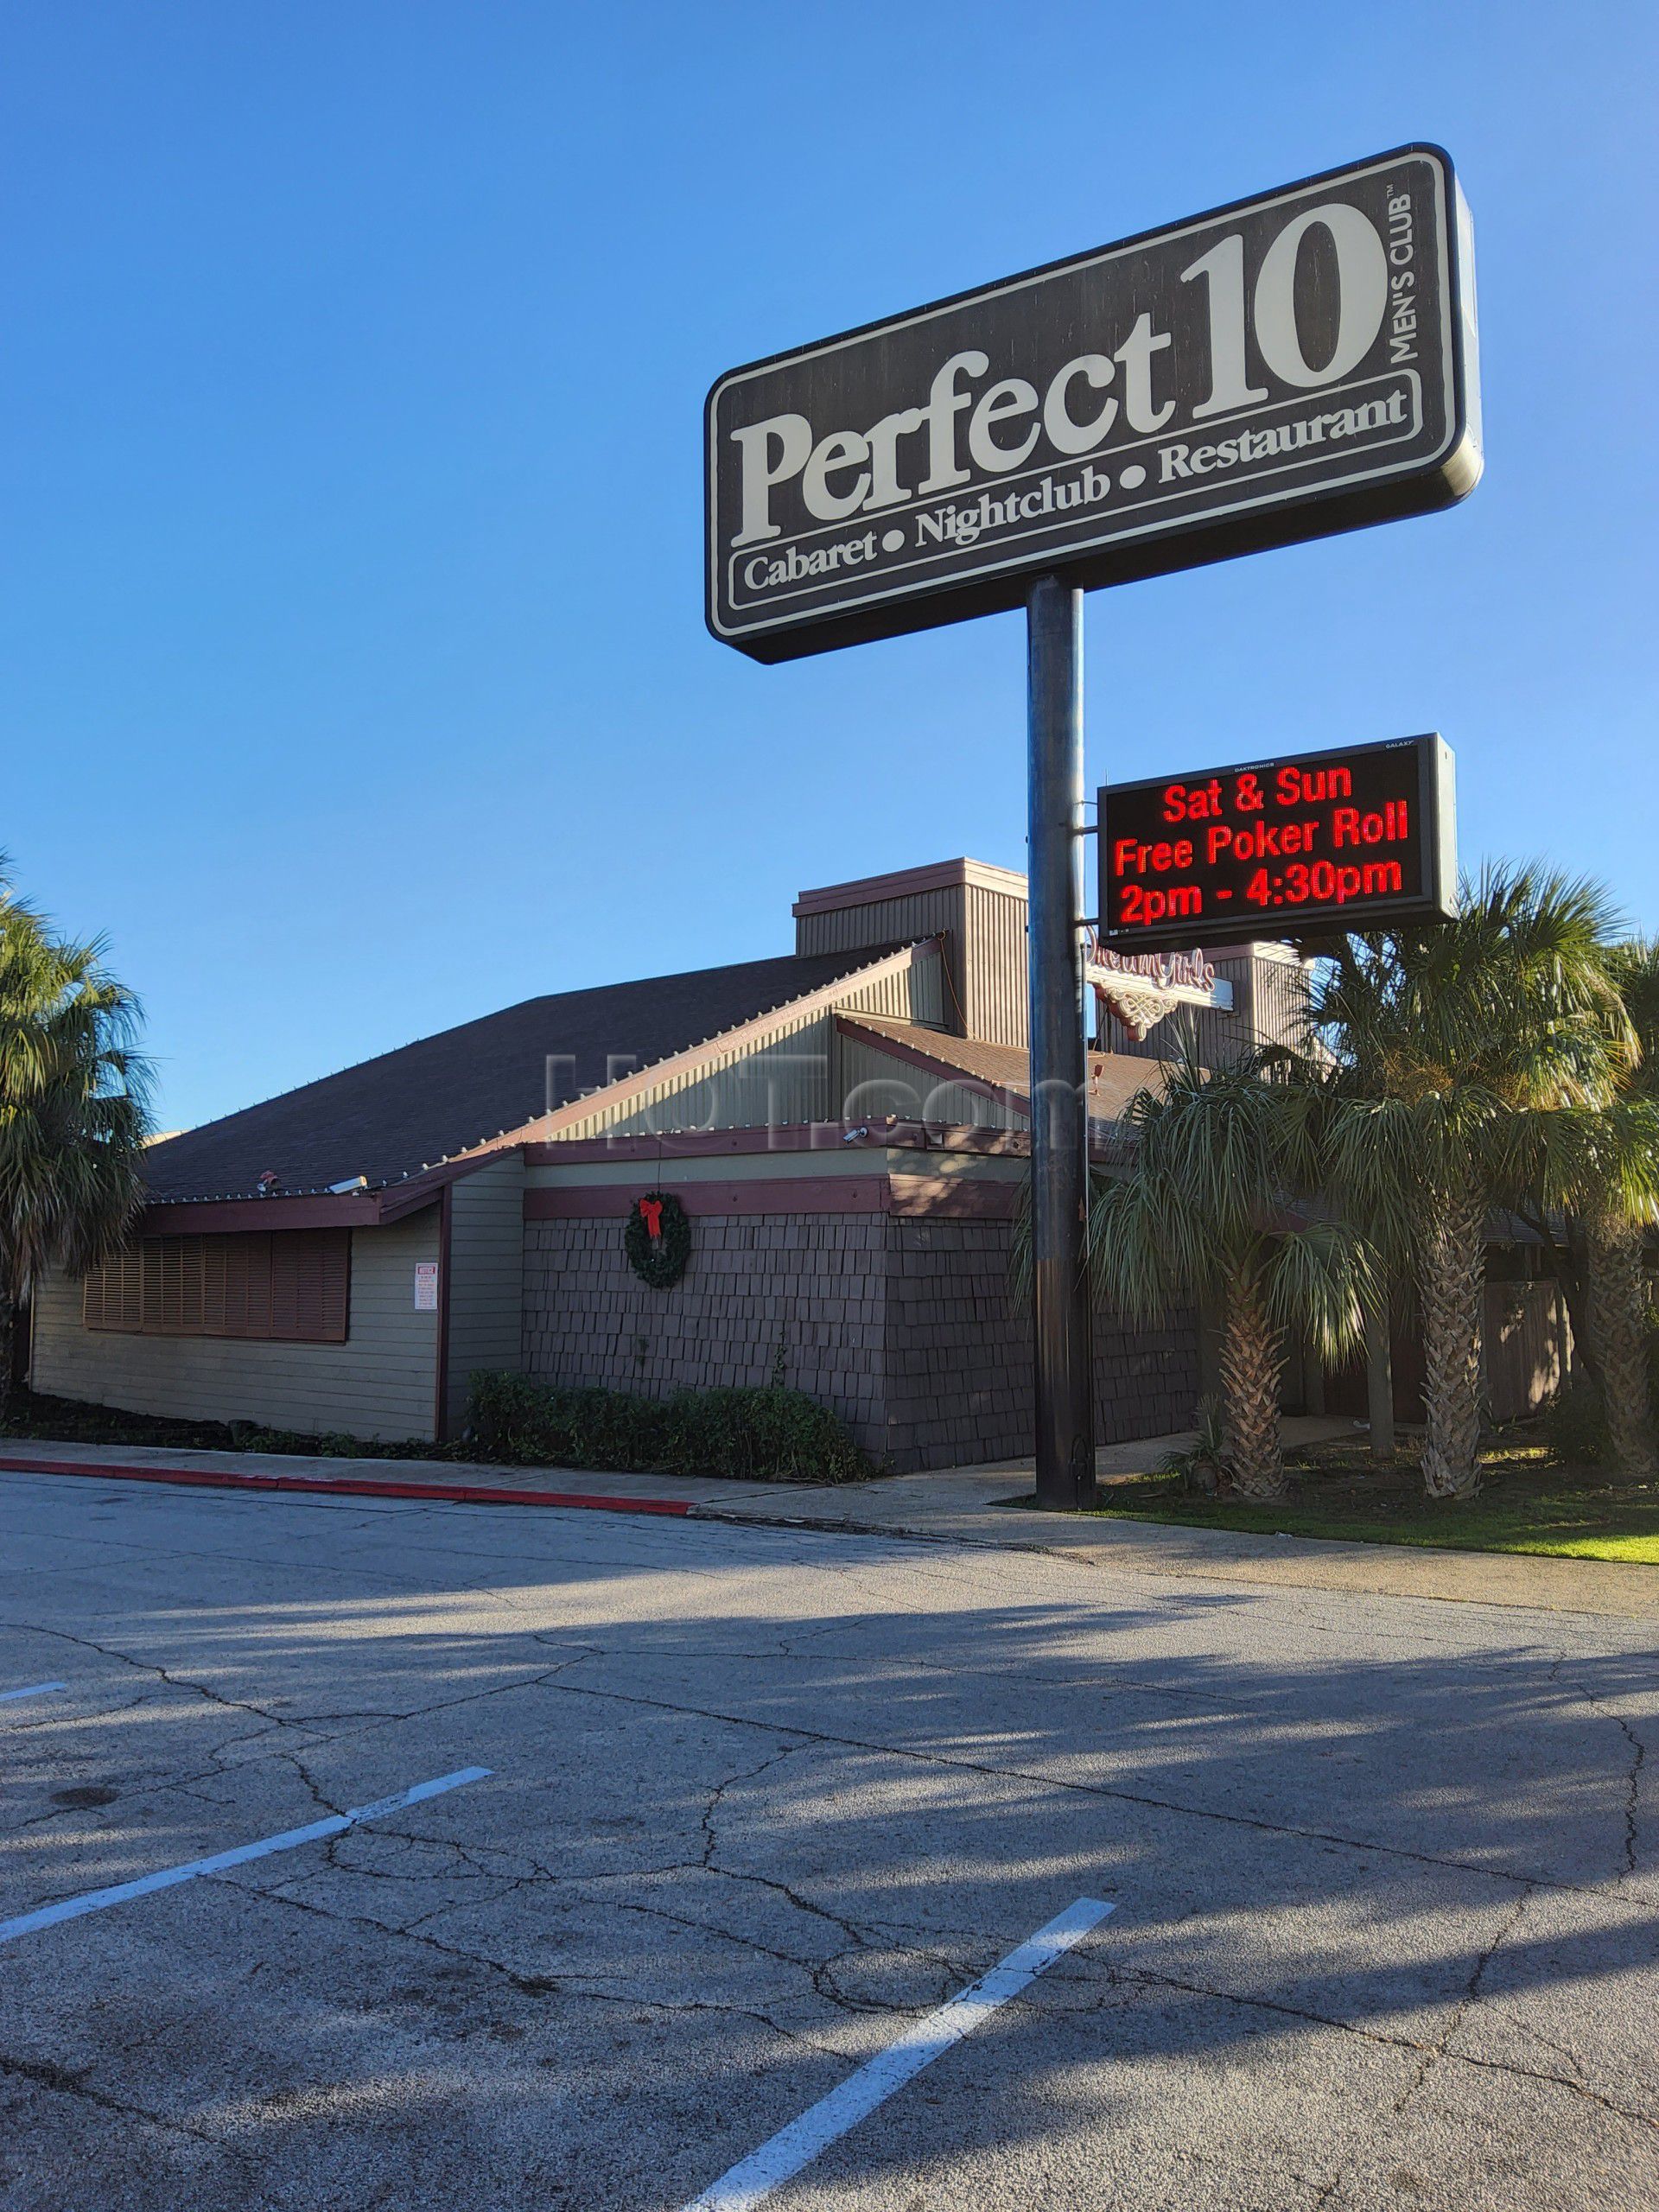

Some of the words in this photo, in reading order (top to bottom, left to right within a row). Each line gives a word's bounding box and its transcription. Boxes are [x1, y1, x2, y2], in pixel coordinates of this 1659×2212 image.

[1389, 271, 1419, 365] MEN'S
[730, 312, 1177, 548] Perfect
[1179, 202, 1389, 420] 10
[744, 531, 878, 591] Cabaret
[914, 465, 1111, 548] Nightclub
[1157, 389, 1408, 484] Restaurant
[1163, 779, 1223, 823] Sat
[1235, 772, 1264, 812] &
[1277, 766, 1353, 806] Sun
[1115, 838, 1193, 876] Free
[1207, 820, 1320, 864] Poker
[1332, 799, 1408, 849] Roll
[1120, 884, 1203, 926] 2pm
[1246, 860, 1403, 906] 4:30pm
